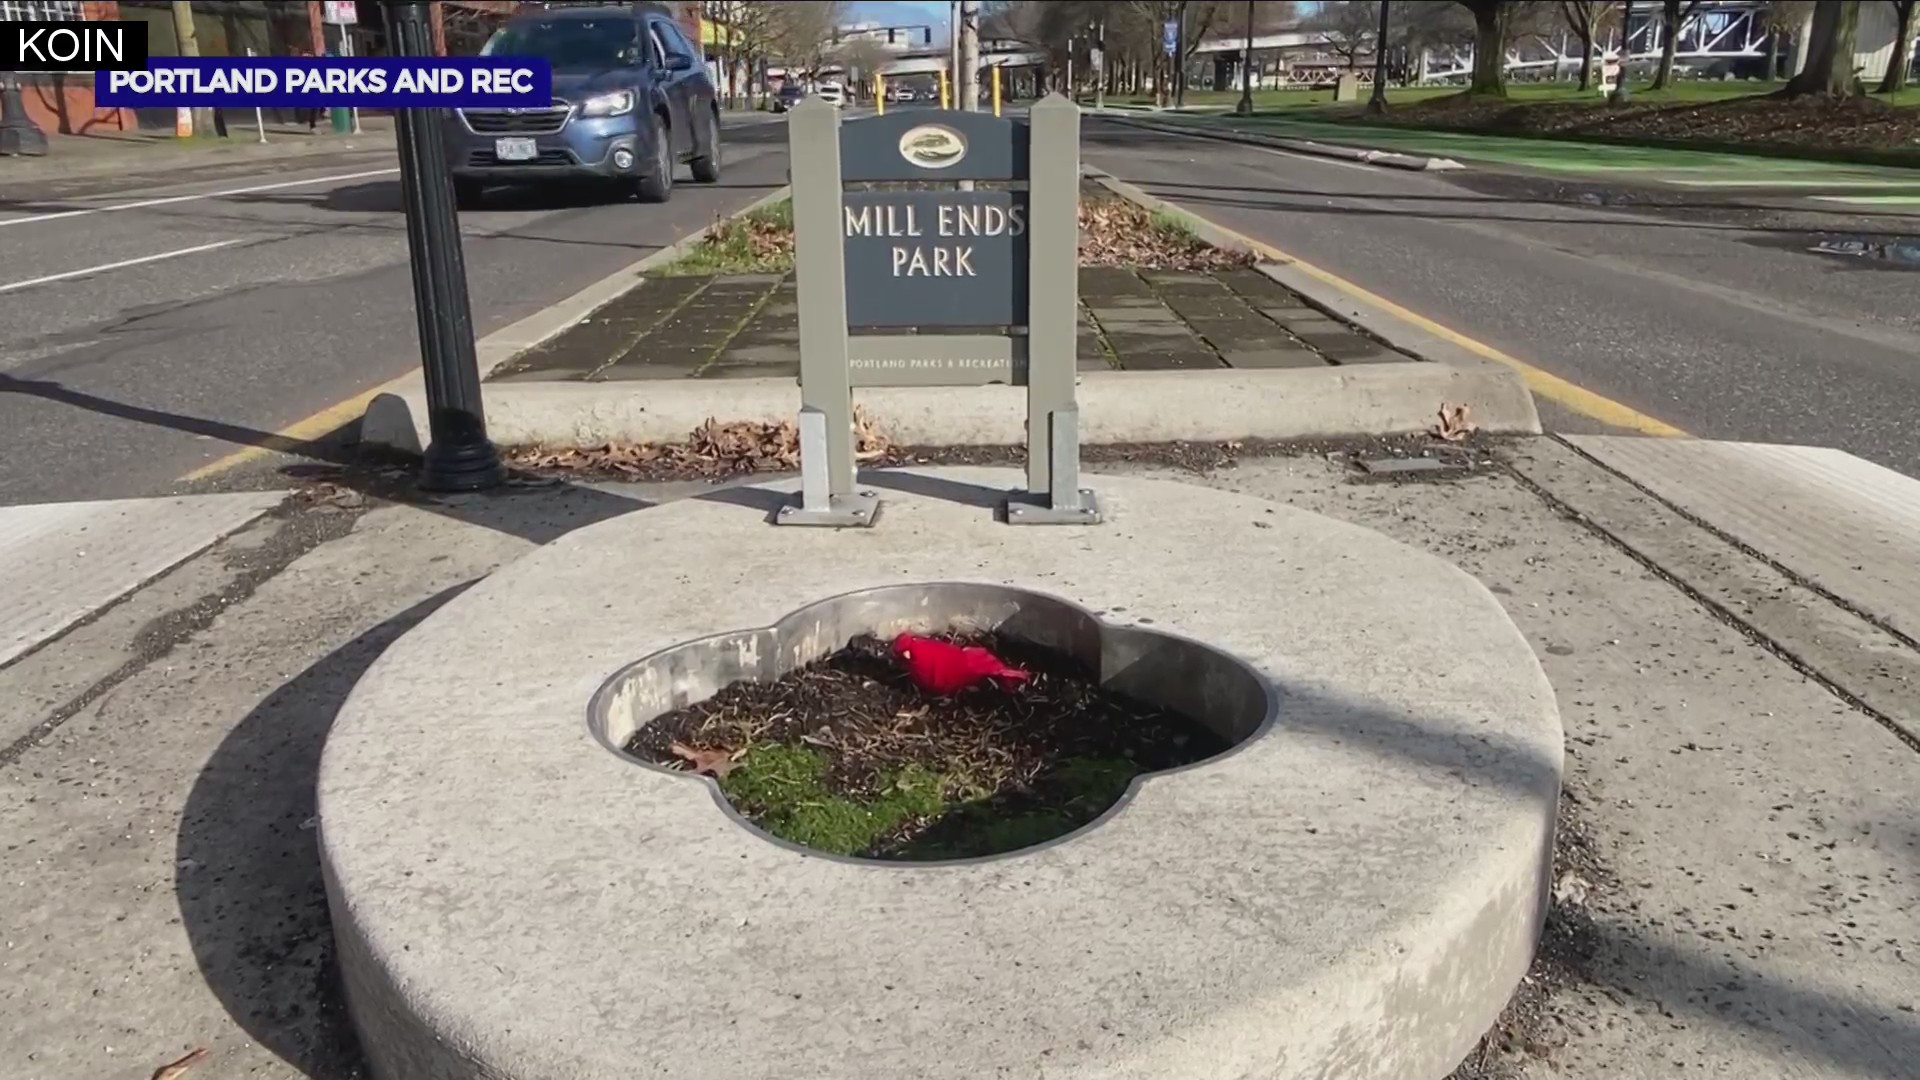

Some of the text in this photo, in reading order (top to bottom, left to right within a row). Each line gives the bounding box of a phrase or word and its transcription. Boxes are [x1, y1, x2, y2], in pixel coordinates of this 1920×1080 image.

[845, 204, 1025, 236] MILL ENDS
[892, 246, 977, 276] PARK
[849, 358, 906, 369] PORTLAND
[910, 358, 943, 369] PARKS
